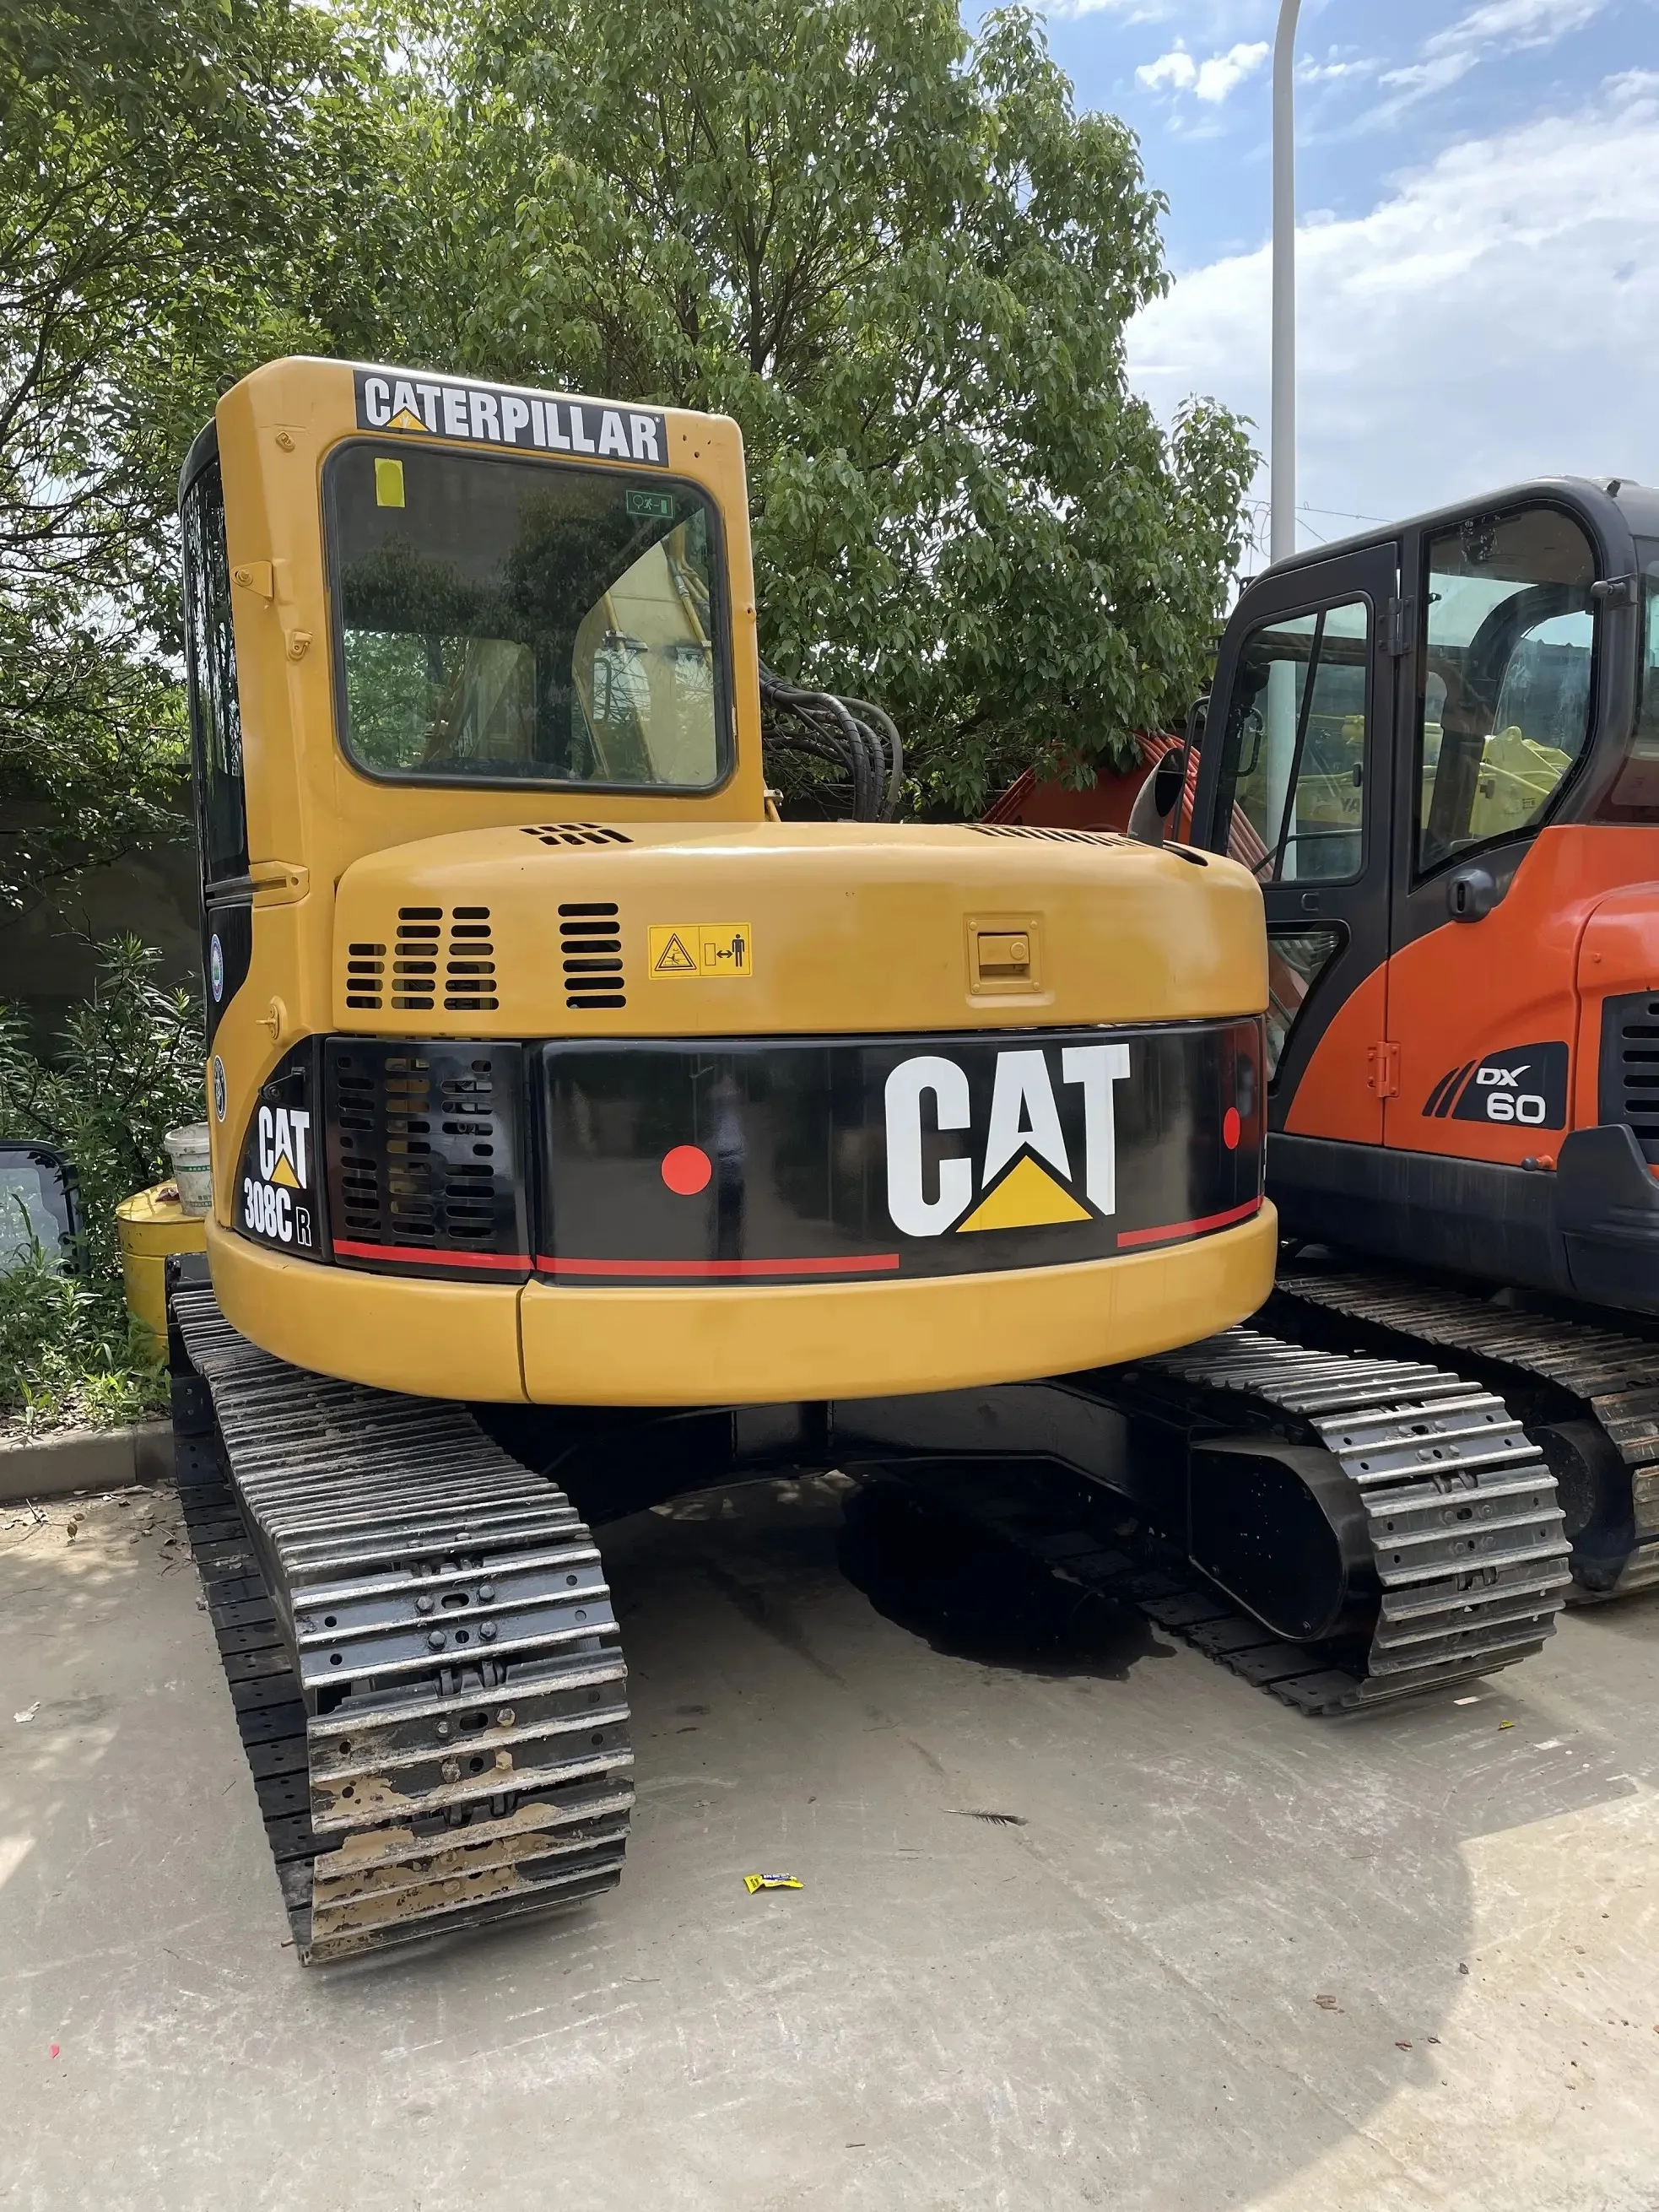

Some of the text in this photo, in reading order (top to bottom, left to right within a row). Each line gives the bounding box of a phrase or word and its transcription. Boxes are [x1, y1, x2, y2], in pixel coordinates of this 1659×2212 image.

[365, 377, 660, 462] CATERPILLAR
[1476, 1065, 1532, 1087] DX
[1487, 1092, 1546, 1124] 60
[258, 1106, 311, 1189] CAT
[884, 1043, 1131, 1237] CAT
[244, 1177, 312, 1247] 308C R
